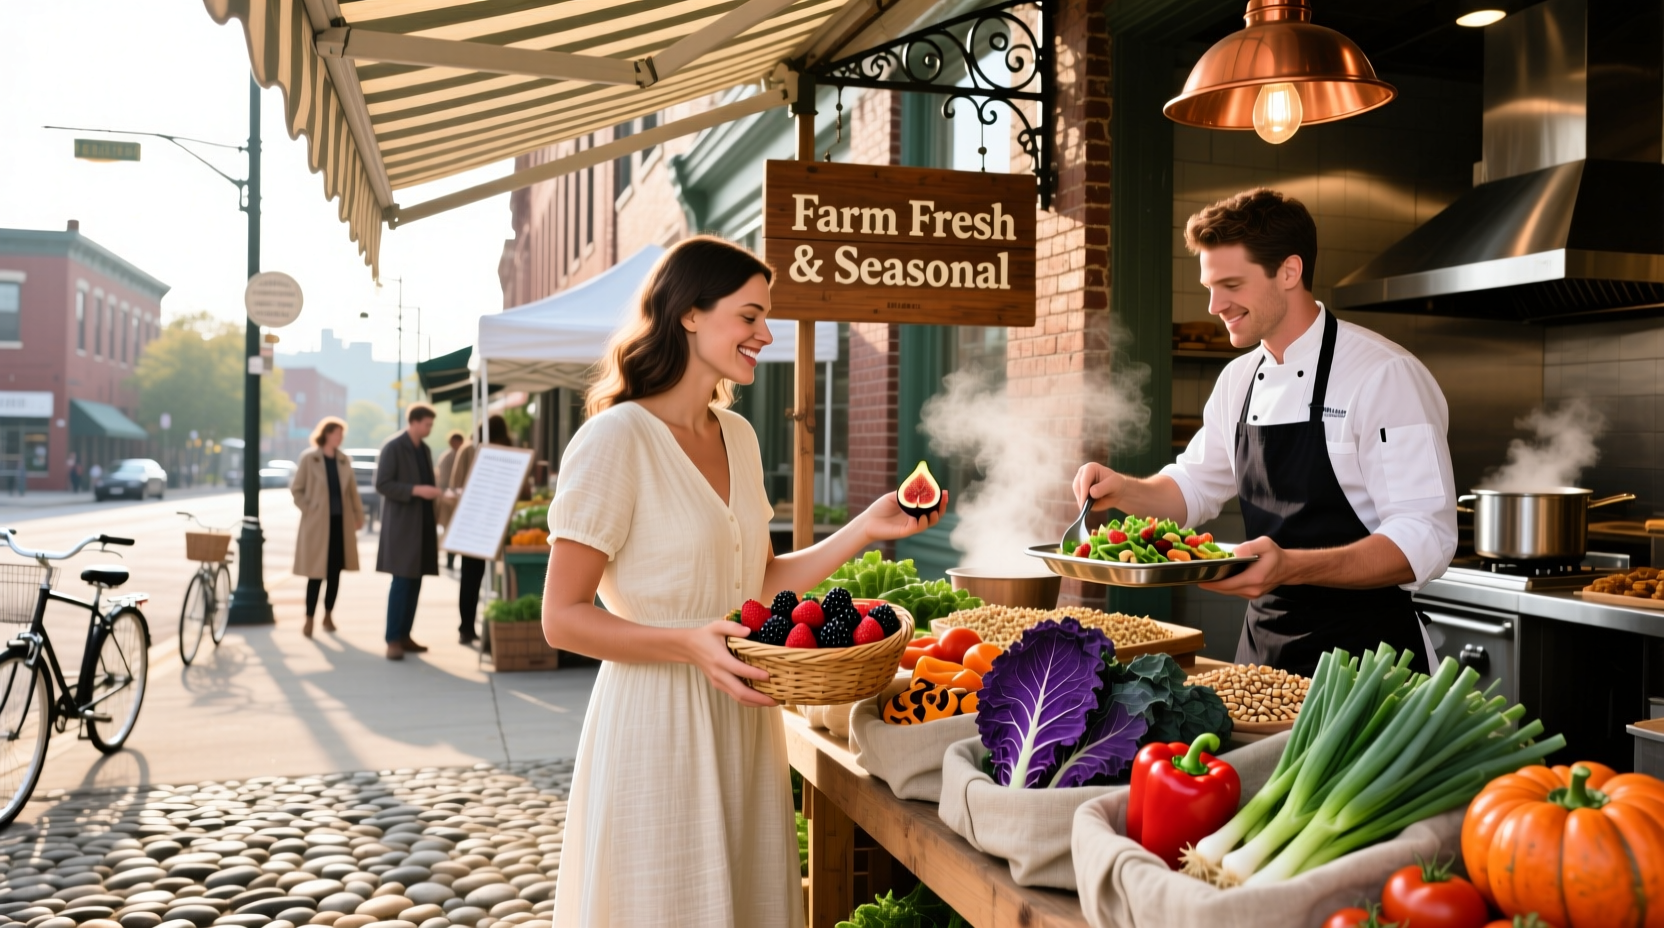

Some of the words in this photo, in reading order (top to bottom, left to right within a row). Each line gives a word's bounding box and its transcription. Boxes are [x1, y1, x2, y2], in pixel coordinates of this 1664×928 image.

[791, 193, 899, 236] Farm
[908, 199, 1017, 241] Fresh
[788, 244, 824, 284] &
[834, 245, 1011, 290] Seasonal
